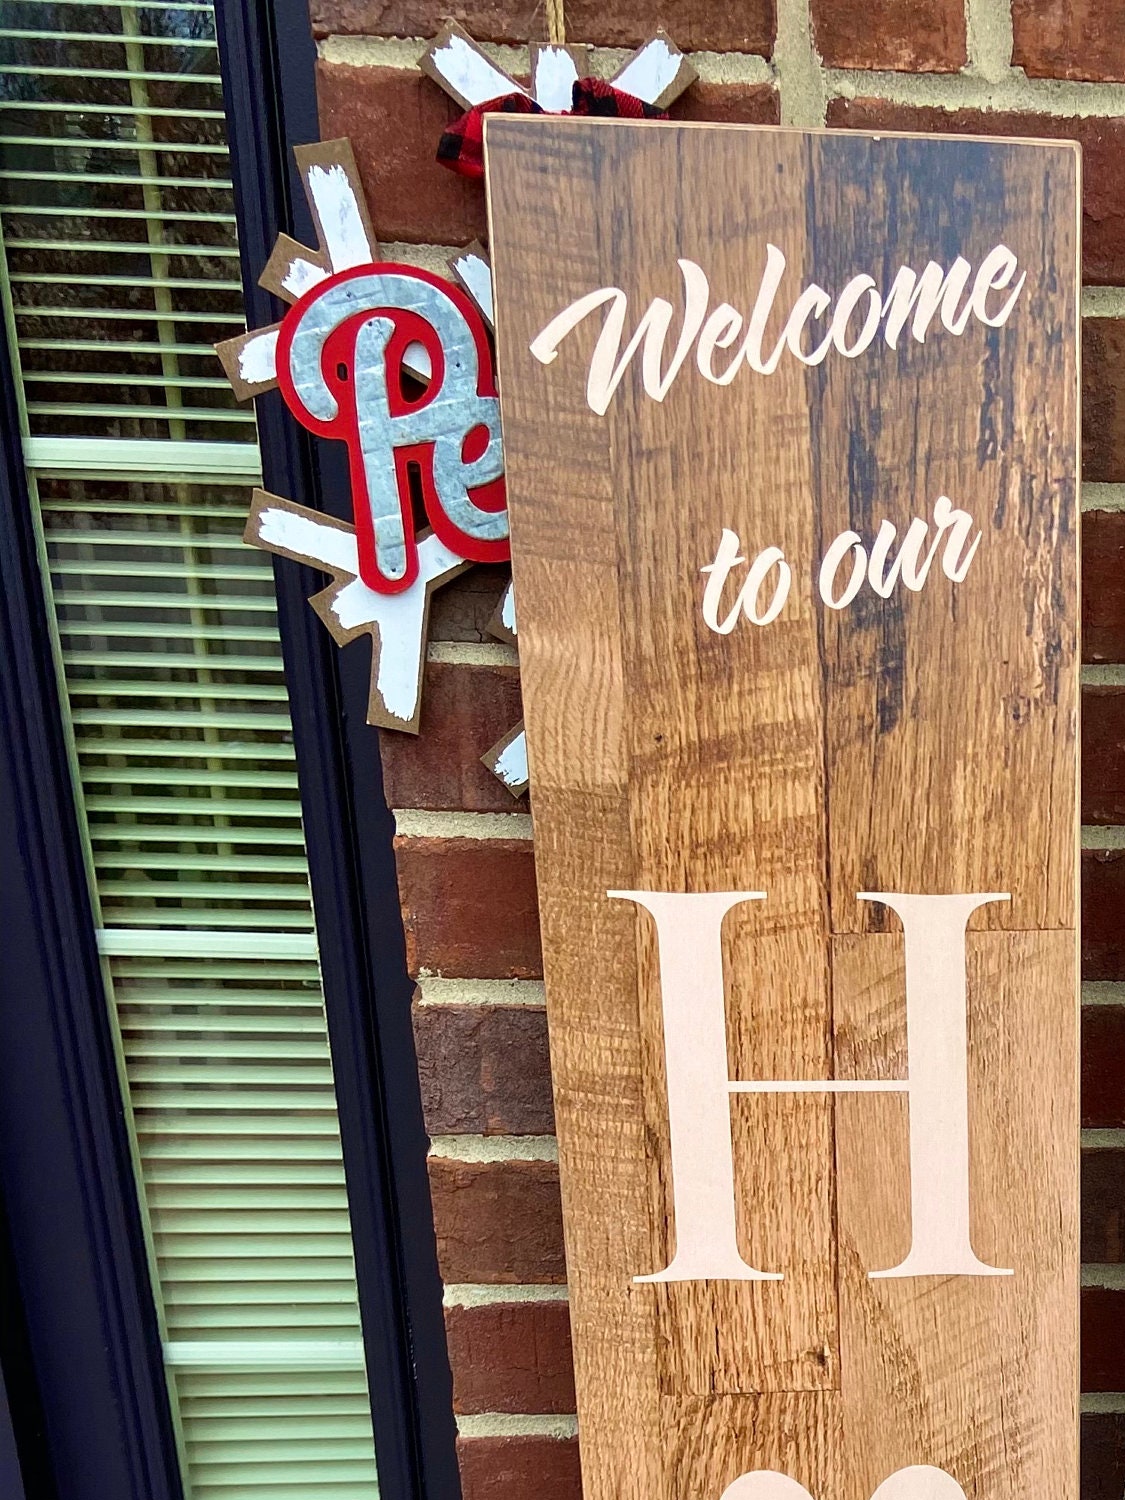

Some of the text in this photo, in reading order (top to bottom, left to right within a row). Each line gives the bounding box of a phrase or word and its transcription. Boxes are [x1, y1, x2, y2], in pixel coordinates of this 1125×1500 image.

[529, 243, 1026, 416] Welcome
[700, 495, 982, 636] to our
